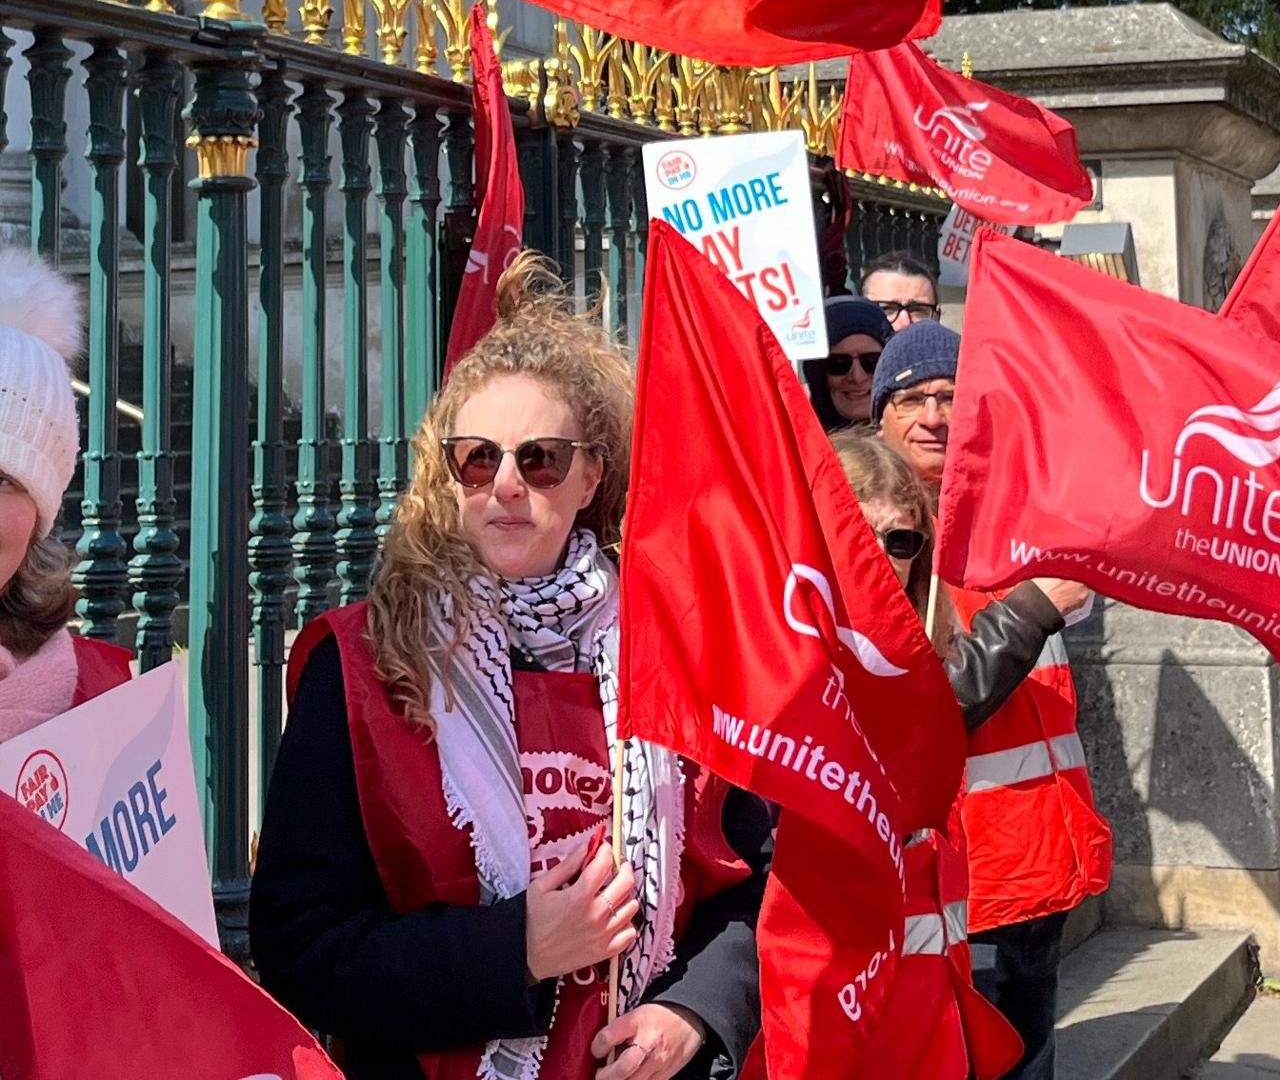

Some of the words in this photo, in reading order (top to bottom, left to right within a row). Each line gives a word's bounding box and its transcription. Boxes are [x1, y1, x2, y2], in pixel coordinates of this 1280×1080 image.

[662, 199, 703, 234] NO
[706, 172, 789, 224] MORE
[701, 226, 743, 275] AY
[85, 759, 177, 878] MORE
